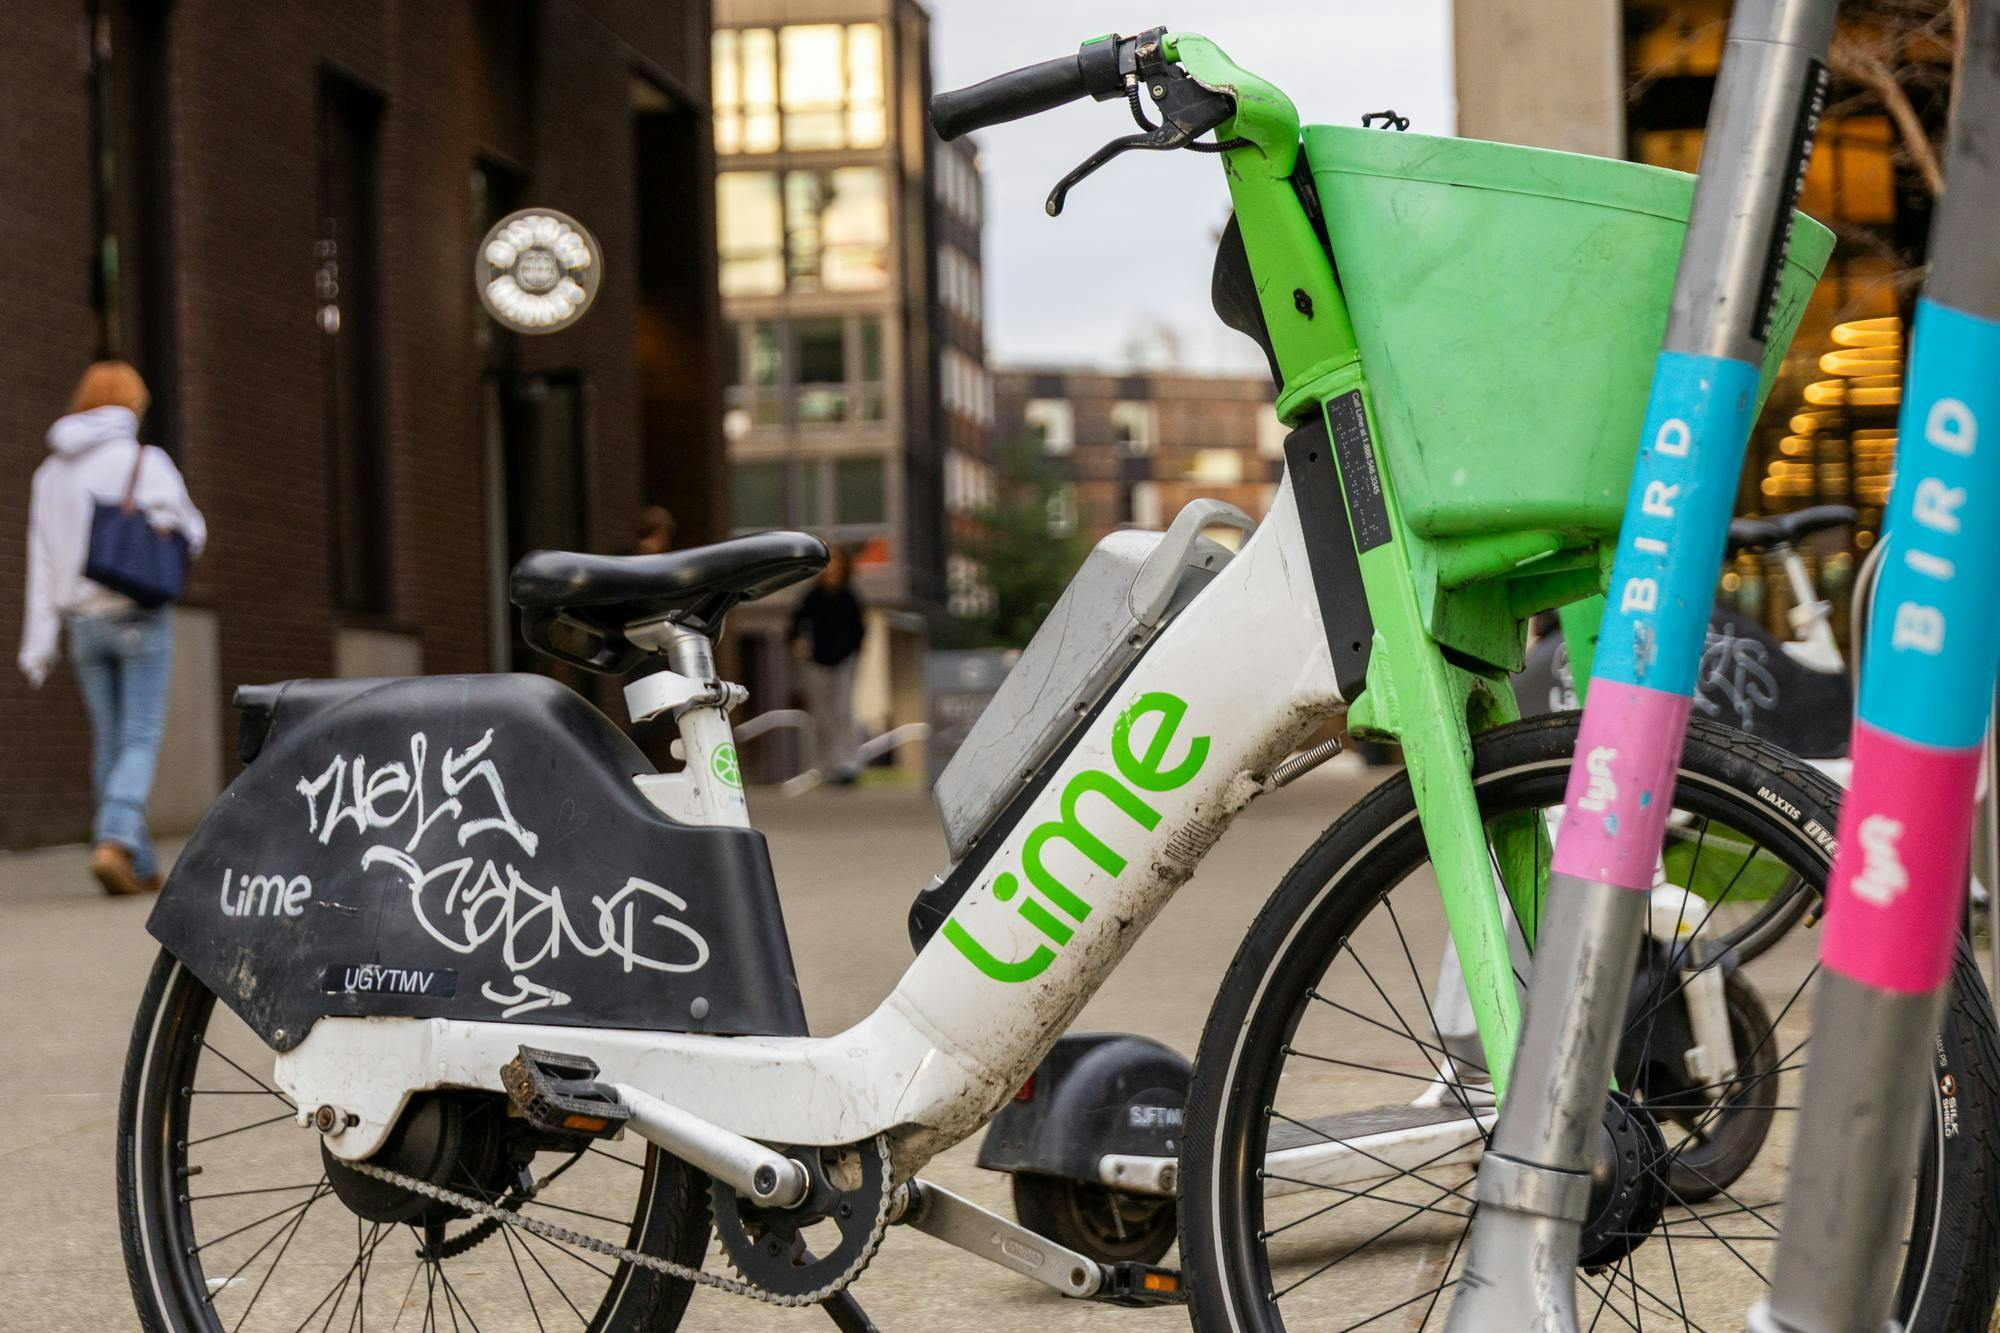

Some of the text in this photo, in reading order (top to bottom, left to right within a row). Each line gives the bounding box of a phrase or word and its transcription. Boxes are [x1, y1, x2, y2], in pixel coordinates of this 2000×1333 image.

[1352, 392, 1361, 408] Call
[1355, 408, 1365, 427] Lime
[1620, 418, 1691, 615] BIRD
[1891, 397, 1979, 657] BIRD
[1578, 746, 1618, 811] lyft
[1757, 786, 1802, 820] MAXXIS
[941, 691, 1211, 983] Lime
[220, 868, 312, 916] Lime
[344, 967, 435, 994] UGYTMV
[1942, 1097, 1952, 1137] SHIELD
[1949, 1097, 1960, 1136] SILK
